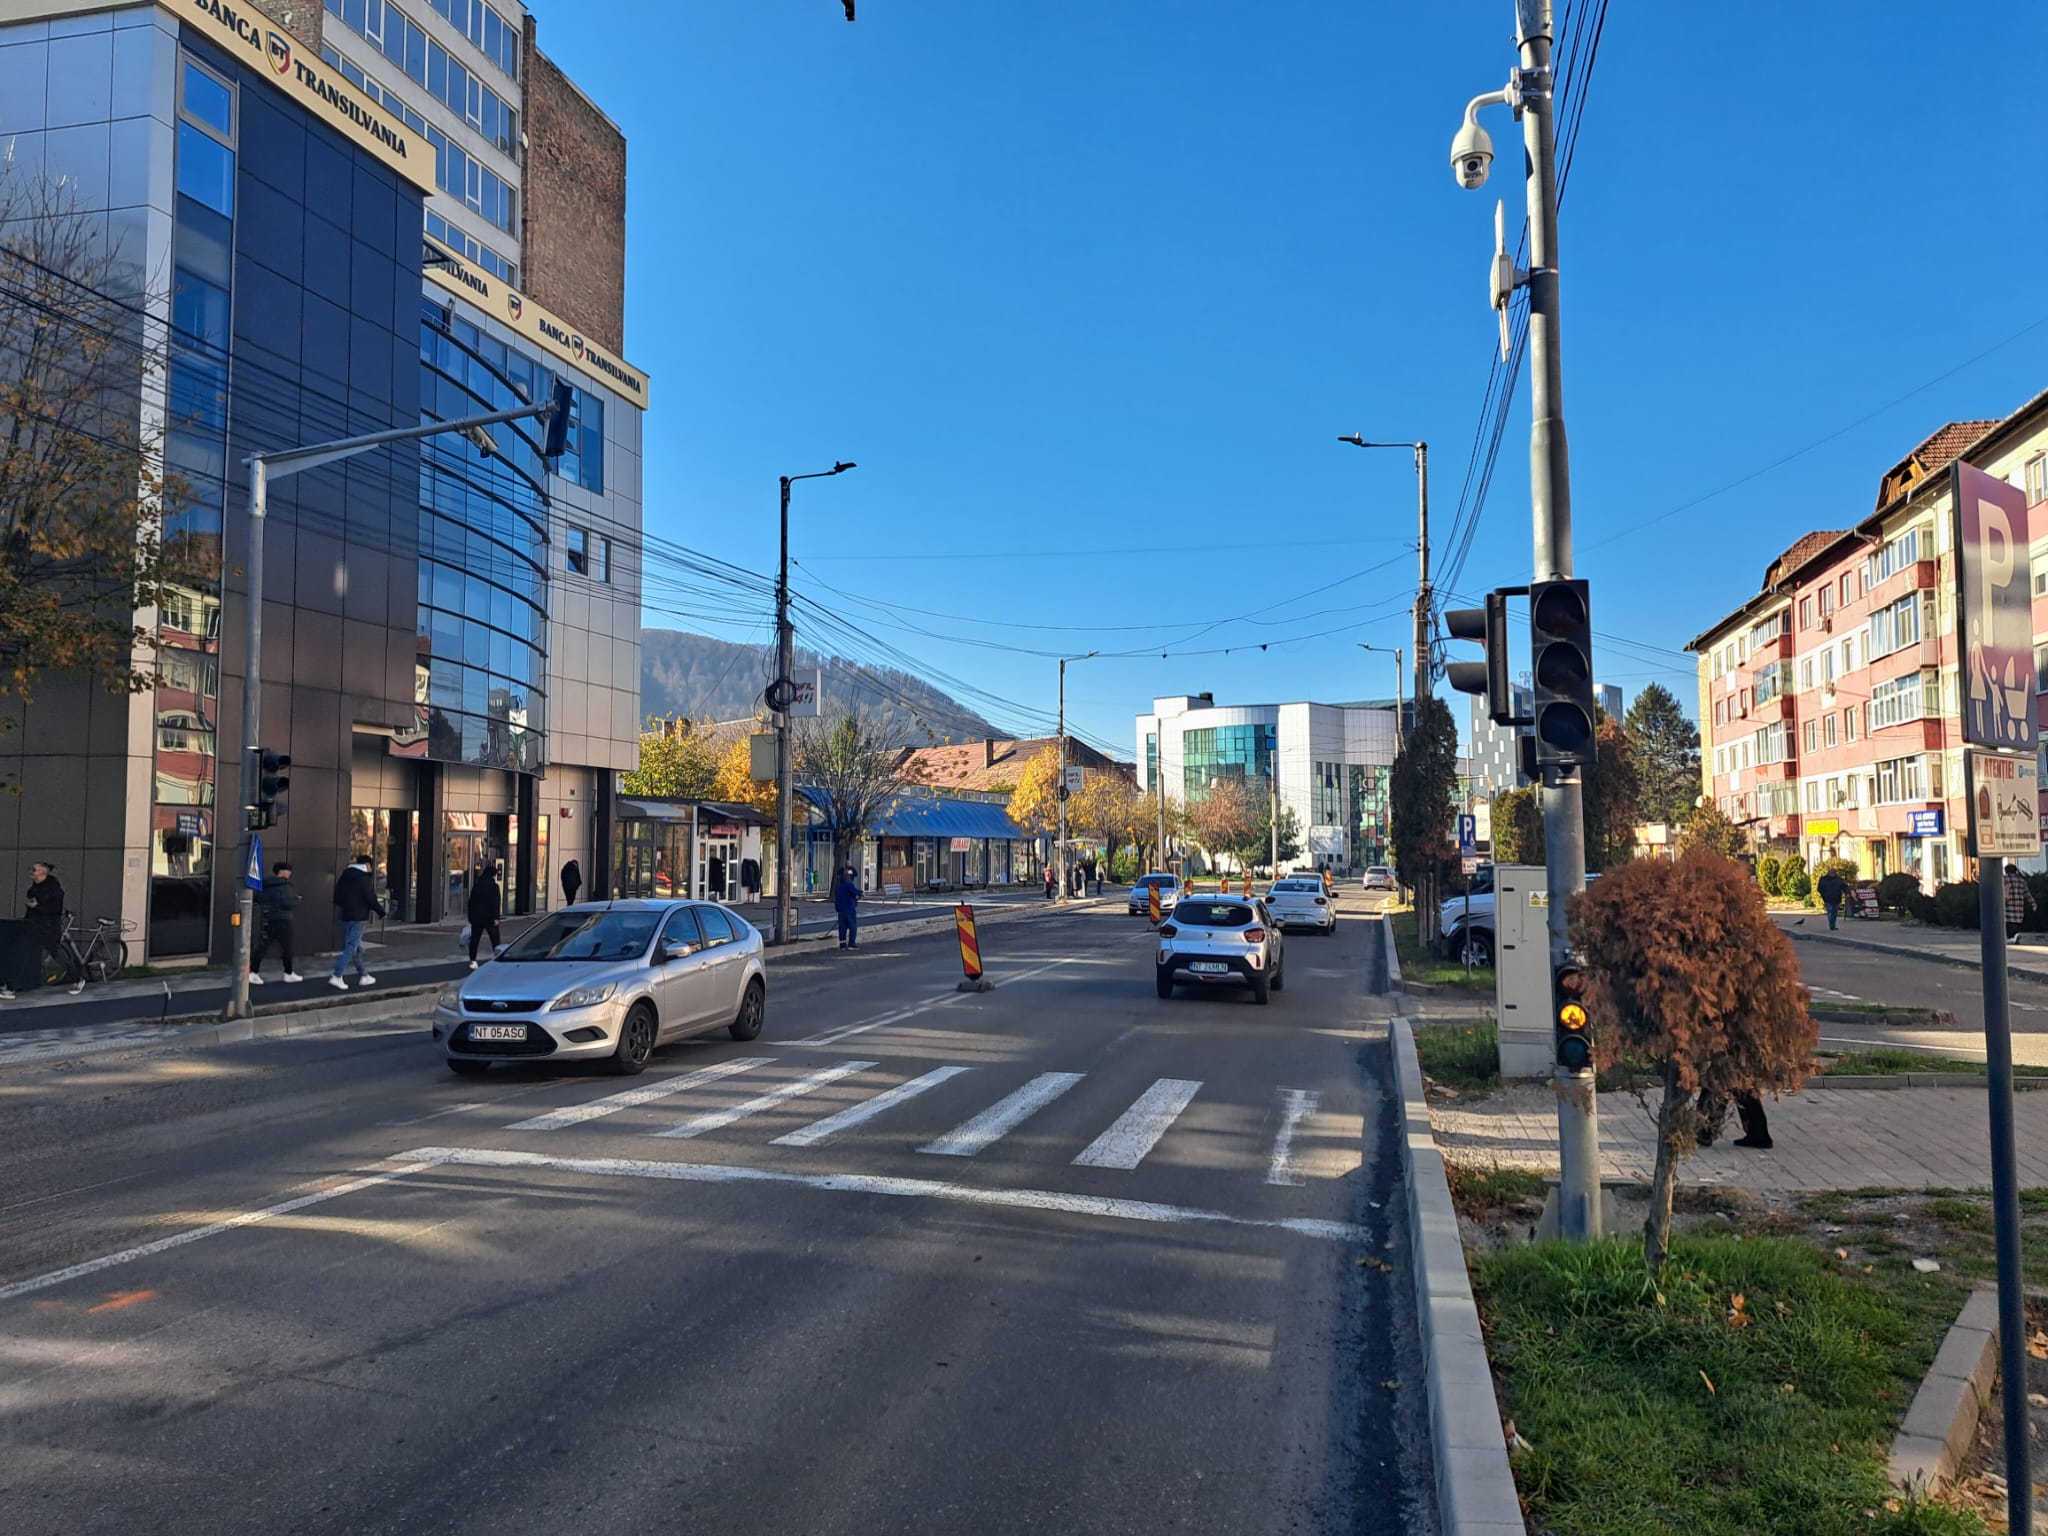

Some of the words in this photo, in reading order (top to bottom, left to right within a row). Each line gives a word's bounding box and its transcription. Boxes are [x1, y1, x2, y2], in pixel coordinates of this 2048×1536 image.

[270, 43, 286, 60] BT
[294, 59, 407, 158] TRANSILVANIA
[539, 318, 570, 348] BANCA
[585, 348, 641, 394] TRANSILVANIA
[1978, 498, 2015, 647] P
[1463, 816, 1473, 842] P
[475, 1027, 488, 1038] NT
